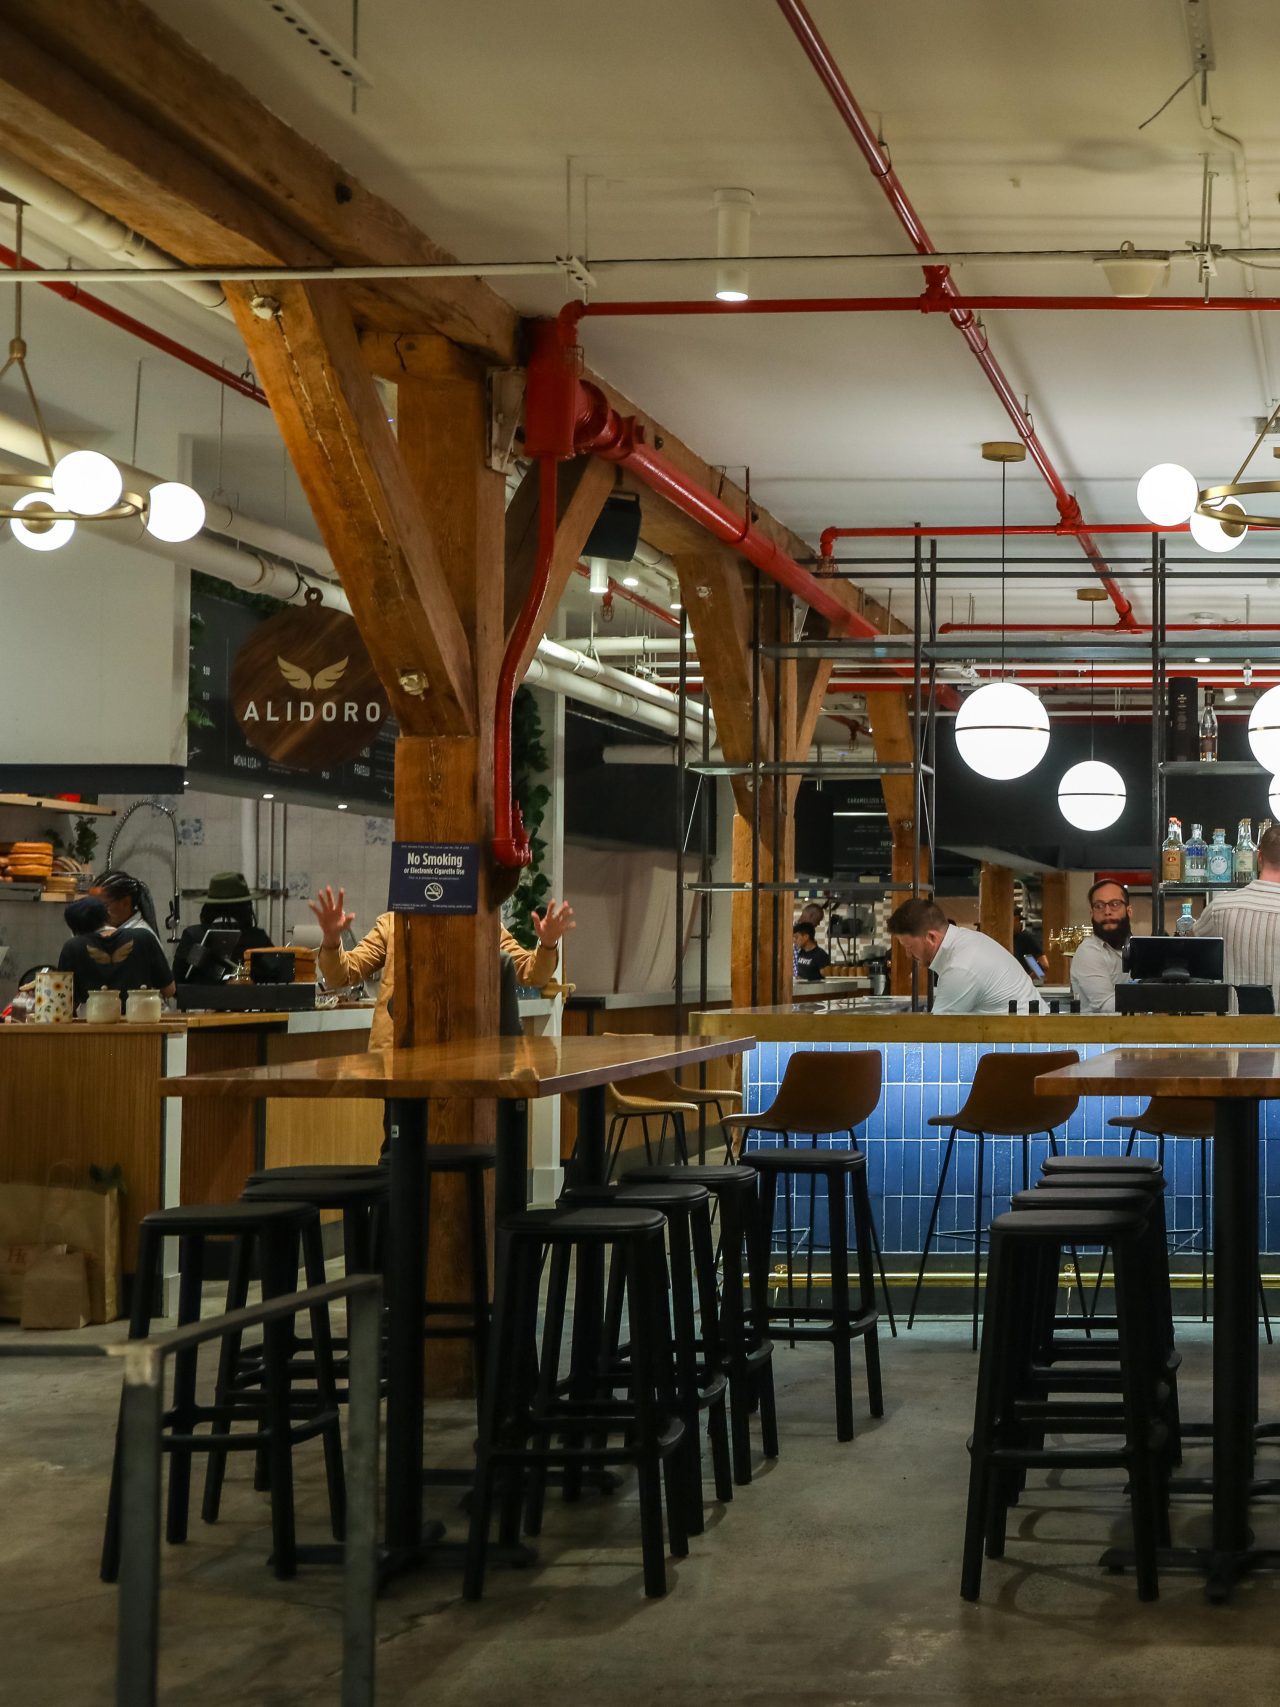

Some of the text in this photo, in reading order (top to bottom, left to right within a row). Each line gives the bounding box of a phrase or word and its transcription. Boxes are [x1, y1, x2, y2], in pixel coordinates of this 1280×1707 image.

[243, 701, 381, 722] ALIDORO
[407, 852, 463, 868] No Smoking
[410, 867, 433, 875] Electronic
[434, 867, 456, 876] Cigarette
